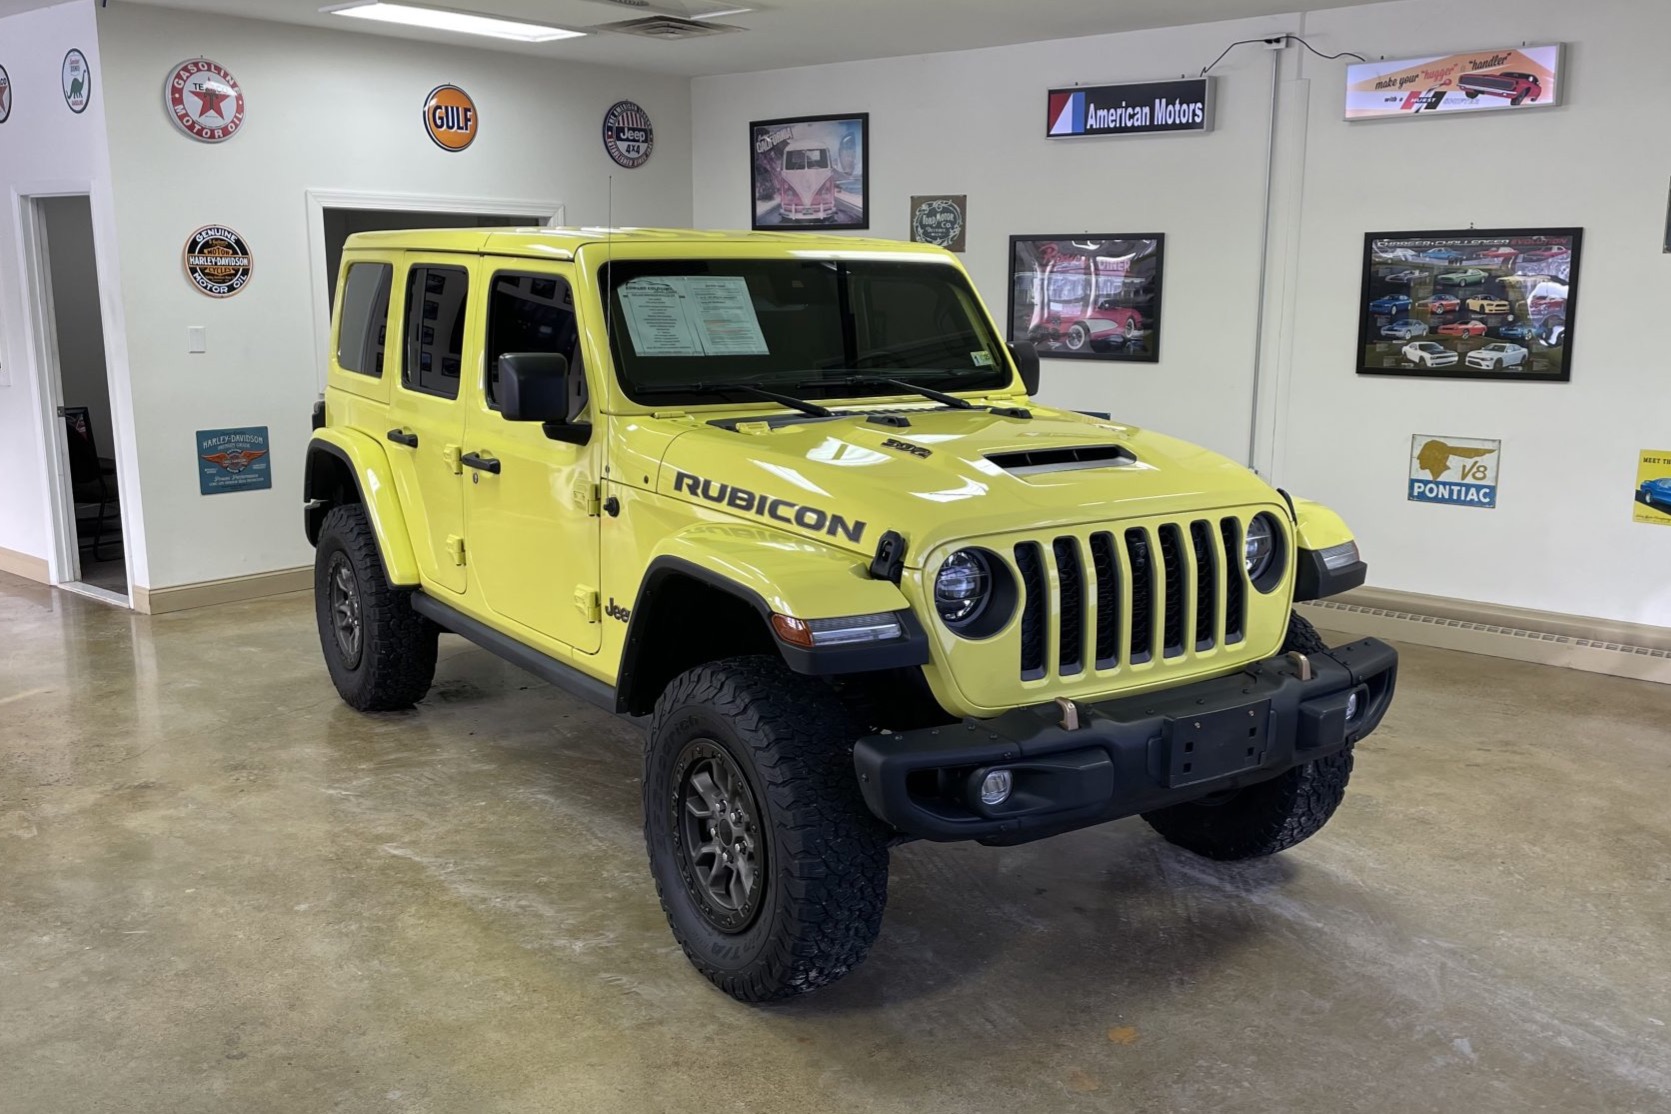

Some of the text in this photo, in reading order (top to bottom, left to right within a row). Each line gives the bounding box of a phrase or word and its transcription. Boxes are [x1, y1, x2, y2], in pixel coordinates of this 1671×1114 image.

[1374, 77, 1397, 90] make
[1398, 73, 1420, 89] your
[1469, 52, 1512, 70] "handler"
[174, 104, 244, 139] MOTOR OIL
[432, 104, 473, 133] GULF
[1086, 98, 1203, 129] American Motors
[620, 127, 646, 143] Jeep
[196, 228, 237, 242] GENUINE
[190, 257, 248, 265] HARLEY-DAVIDSON
[207, 247, 231, 255] MOTOR
[193, 272, 228, 293] MOTOR
[233, 274, 247, 288] OIL
[203, 434, 264, 449] HARLEY-DAVIDSON
[881, 438, 933, 460] 392
[1461, 460, 1488, 481] V8
[1413, 482, 1491, 503] PONTIAC
[674, 471, 867, 544] RUBICON
